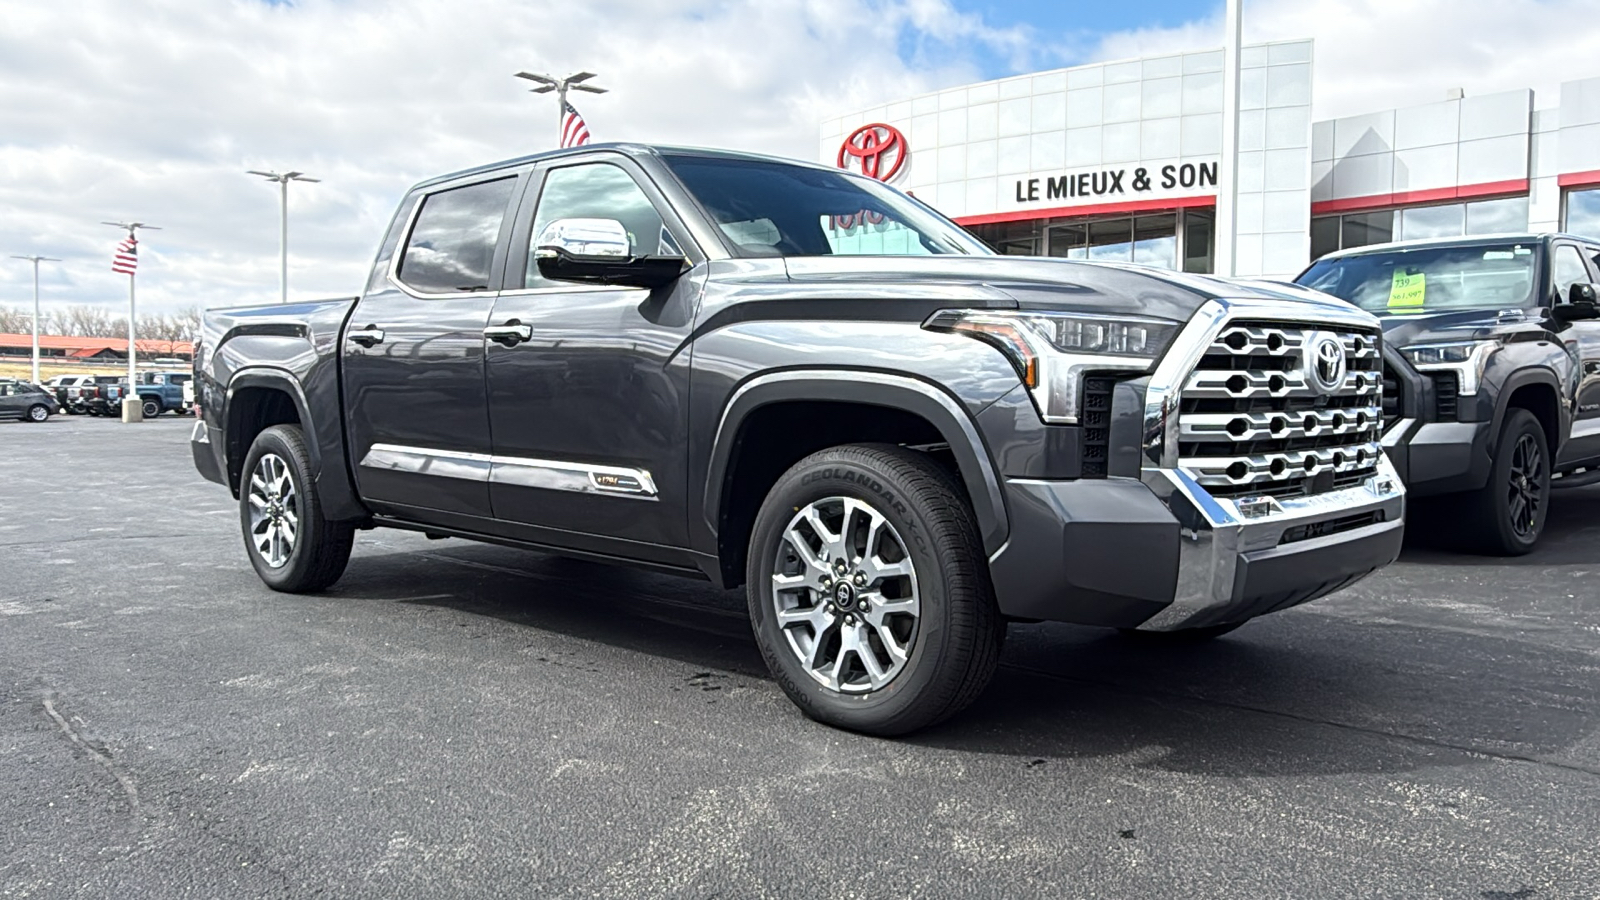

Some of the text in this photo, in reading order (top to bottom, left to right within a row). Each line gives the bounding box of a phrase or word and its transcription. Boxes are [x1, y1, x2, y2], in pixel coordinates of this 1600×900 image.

[1016, 161, 1218, 203] LE MIEUX & SON
[800, 468, 907, 516] GEOLANDAR
[765, 643, 813, 707] YOKOHAMA
